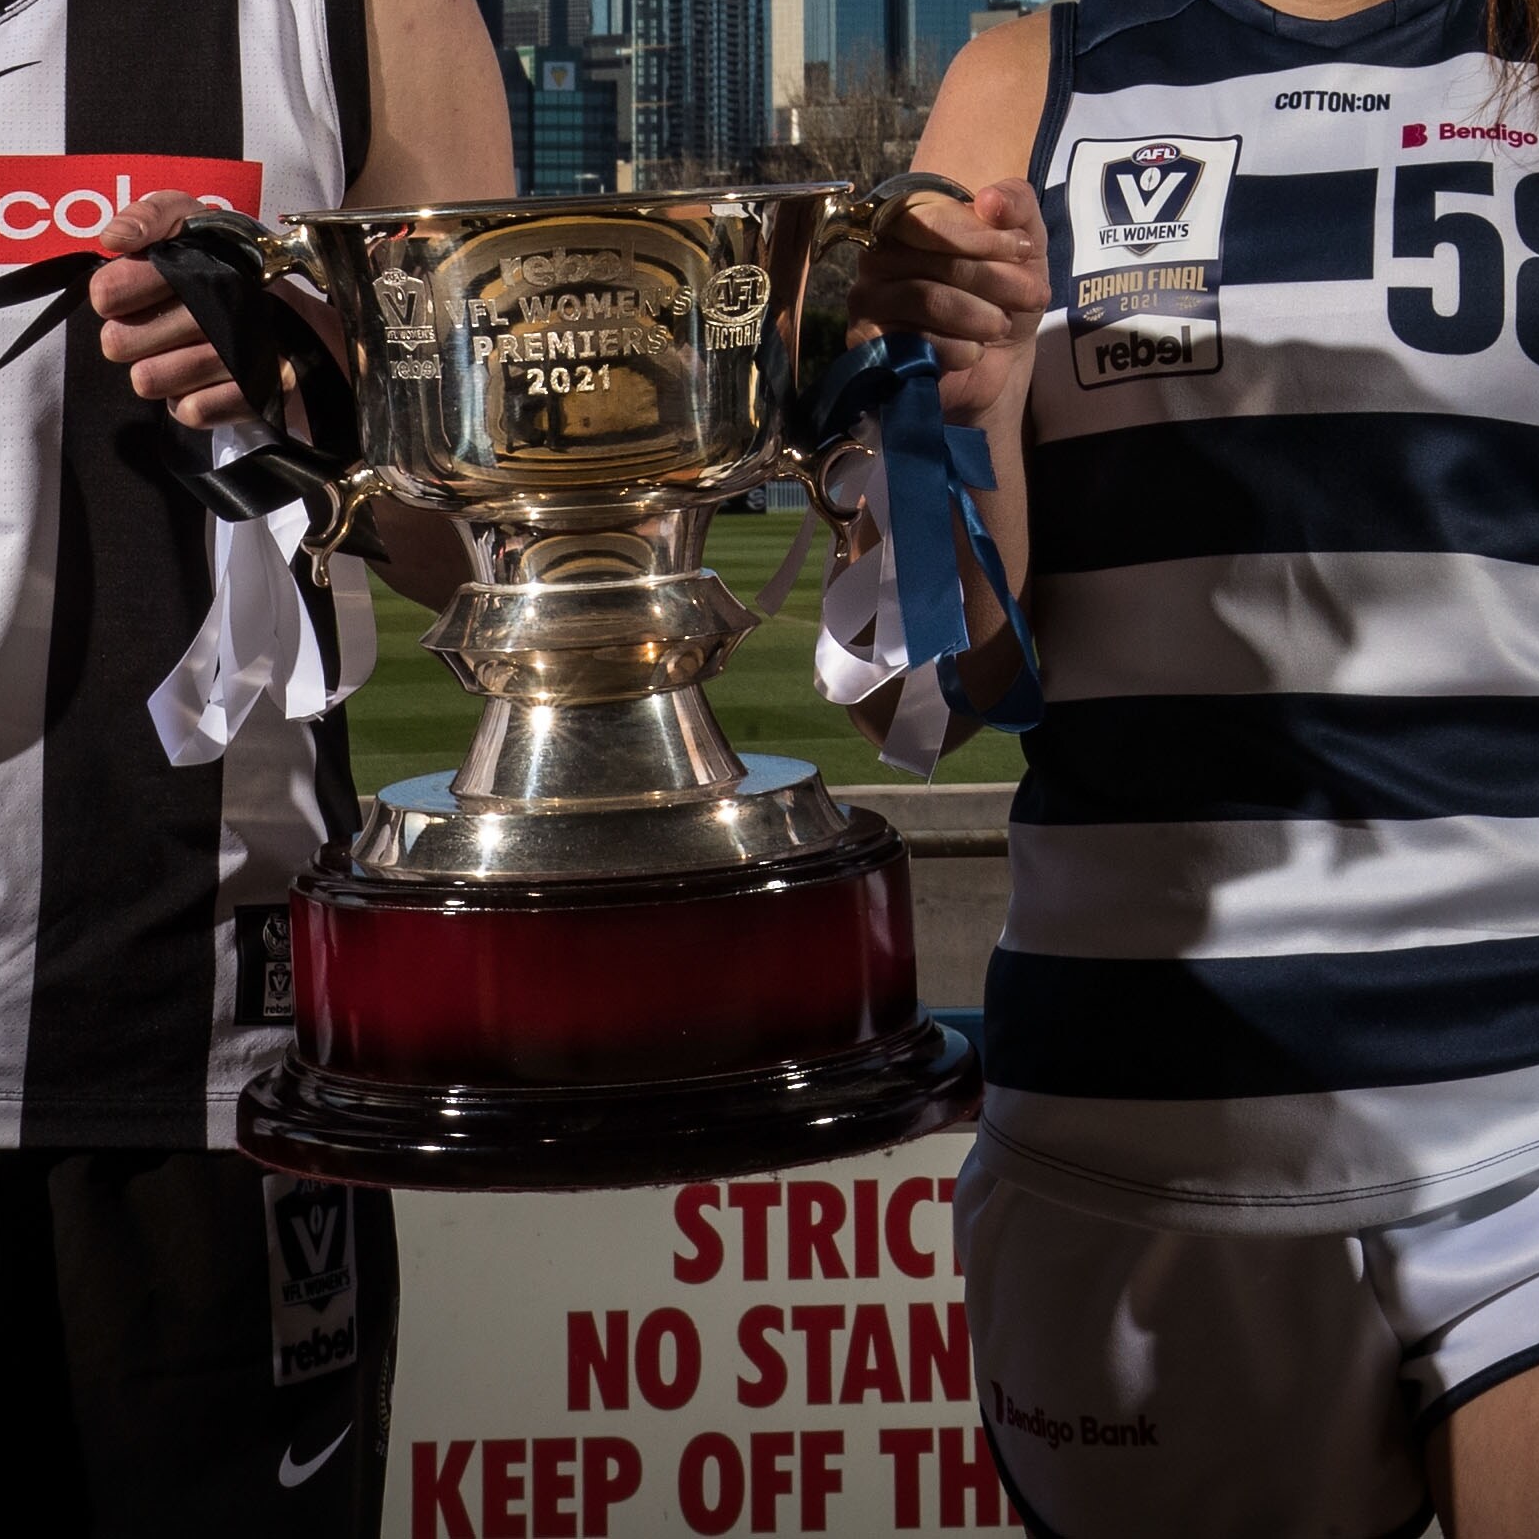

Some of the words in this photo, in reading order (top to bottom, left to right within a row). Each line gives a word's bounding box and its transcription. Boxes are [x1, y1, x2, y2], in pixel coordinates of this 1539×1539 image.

[1275, 90, 1391, 113] COTTON:ON
[1136, 148, 1177, 161] AFL
[1440, 123, 1538, 148] Bendigo
[1099, 229, 1119, 246] VFL
[1124, 223, 1189, 242] WOMEN'S
[444, 298, 509, 328] VFL
[519, 285, 692, 323] WOMEN'S
[706, 276, 764, 312] AFL
[1078, 271, 1143, 309] GRAND
[1147, 266, 1208, 293] FINAL
[1120, 293, 1158, 312] 2021
[474, 325, 669, 365] PREMIERS
[704, 320, 762, 351] VICTORIA
[1095, 325, 1193, 374] rebel
[527, 364, 611, 396] 2021
[673, 1177, 966, 1284] STRIC
[281, 1315, 354, 1377] rebel
[567, 1307, 701, 1411] NO
[1007, 1396, 1073, 1450] Bendigo
[1080, 1414, 1159, 1447] Bank
[411, 1436, 642, 1539] KEEP
[678, 1430, 844, 1536] OFF
[879, 1427, 1027, 1530] TH
